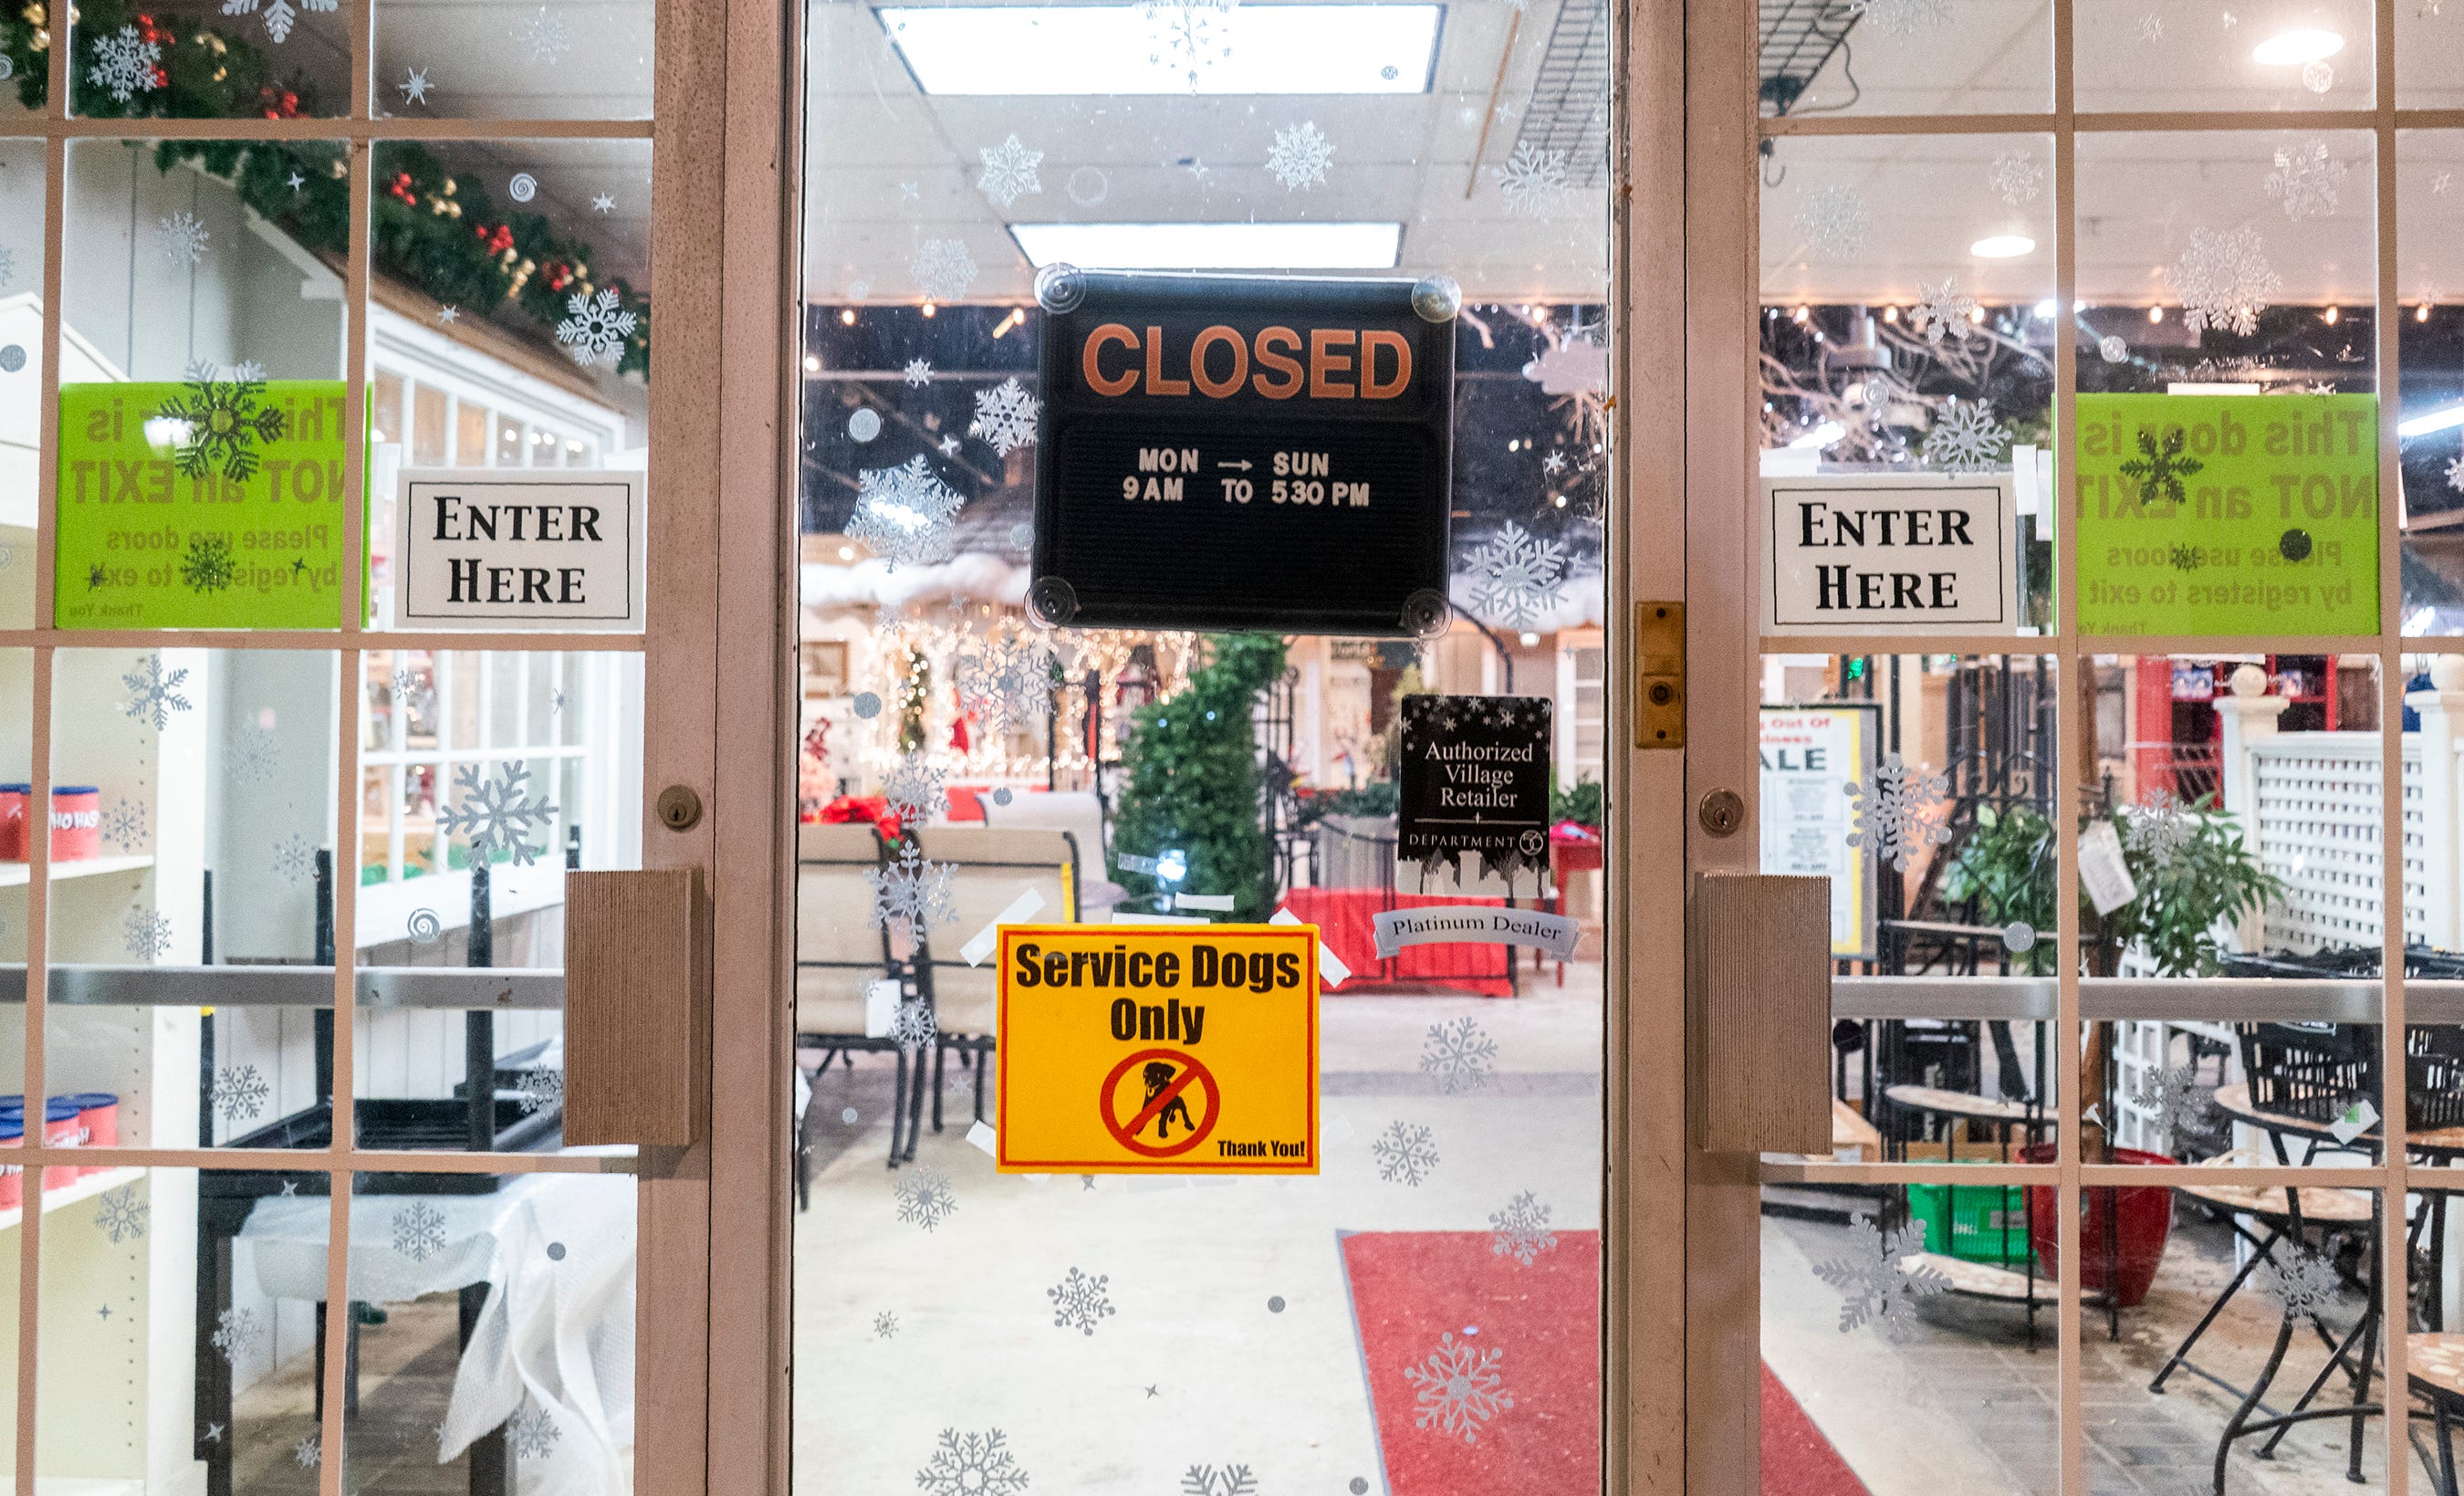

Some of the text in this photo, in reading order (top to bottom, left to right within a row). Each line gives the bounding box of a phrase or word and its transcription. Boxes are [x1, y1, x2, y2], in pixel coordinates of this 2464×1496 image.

[1082, 322, 1413, 400] CLOSED
[1138, 447, 1329, 477] MON SUN
[1220, 477, 1254, 504] TO
[1271, 479, 1325, 506] 530
[1331, 481, 1370, 507] PM
[433, 497, 603, 541] ENTER
[1798, 502, 1974, 547] ENTER
[446, 559, 586, 603] HERE
[1815, 564, 1958, 610] HERE
[1425, 740, 1534, 763] Authorized
[1445, 763, 1515, 790] Village
[1440, 785, 1519, 809] Retailer
[1408, 833, 1517, 849] DEPARTMENT
[1392, 915, 1562, 941] Platinum Dealer
[1016, 943, 1300, 994] Service Dogs
[1111, 998, 1206, 1045] Only
[1217, 1140, 1306, 1157] Thank You!
